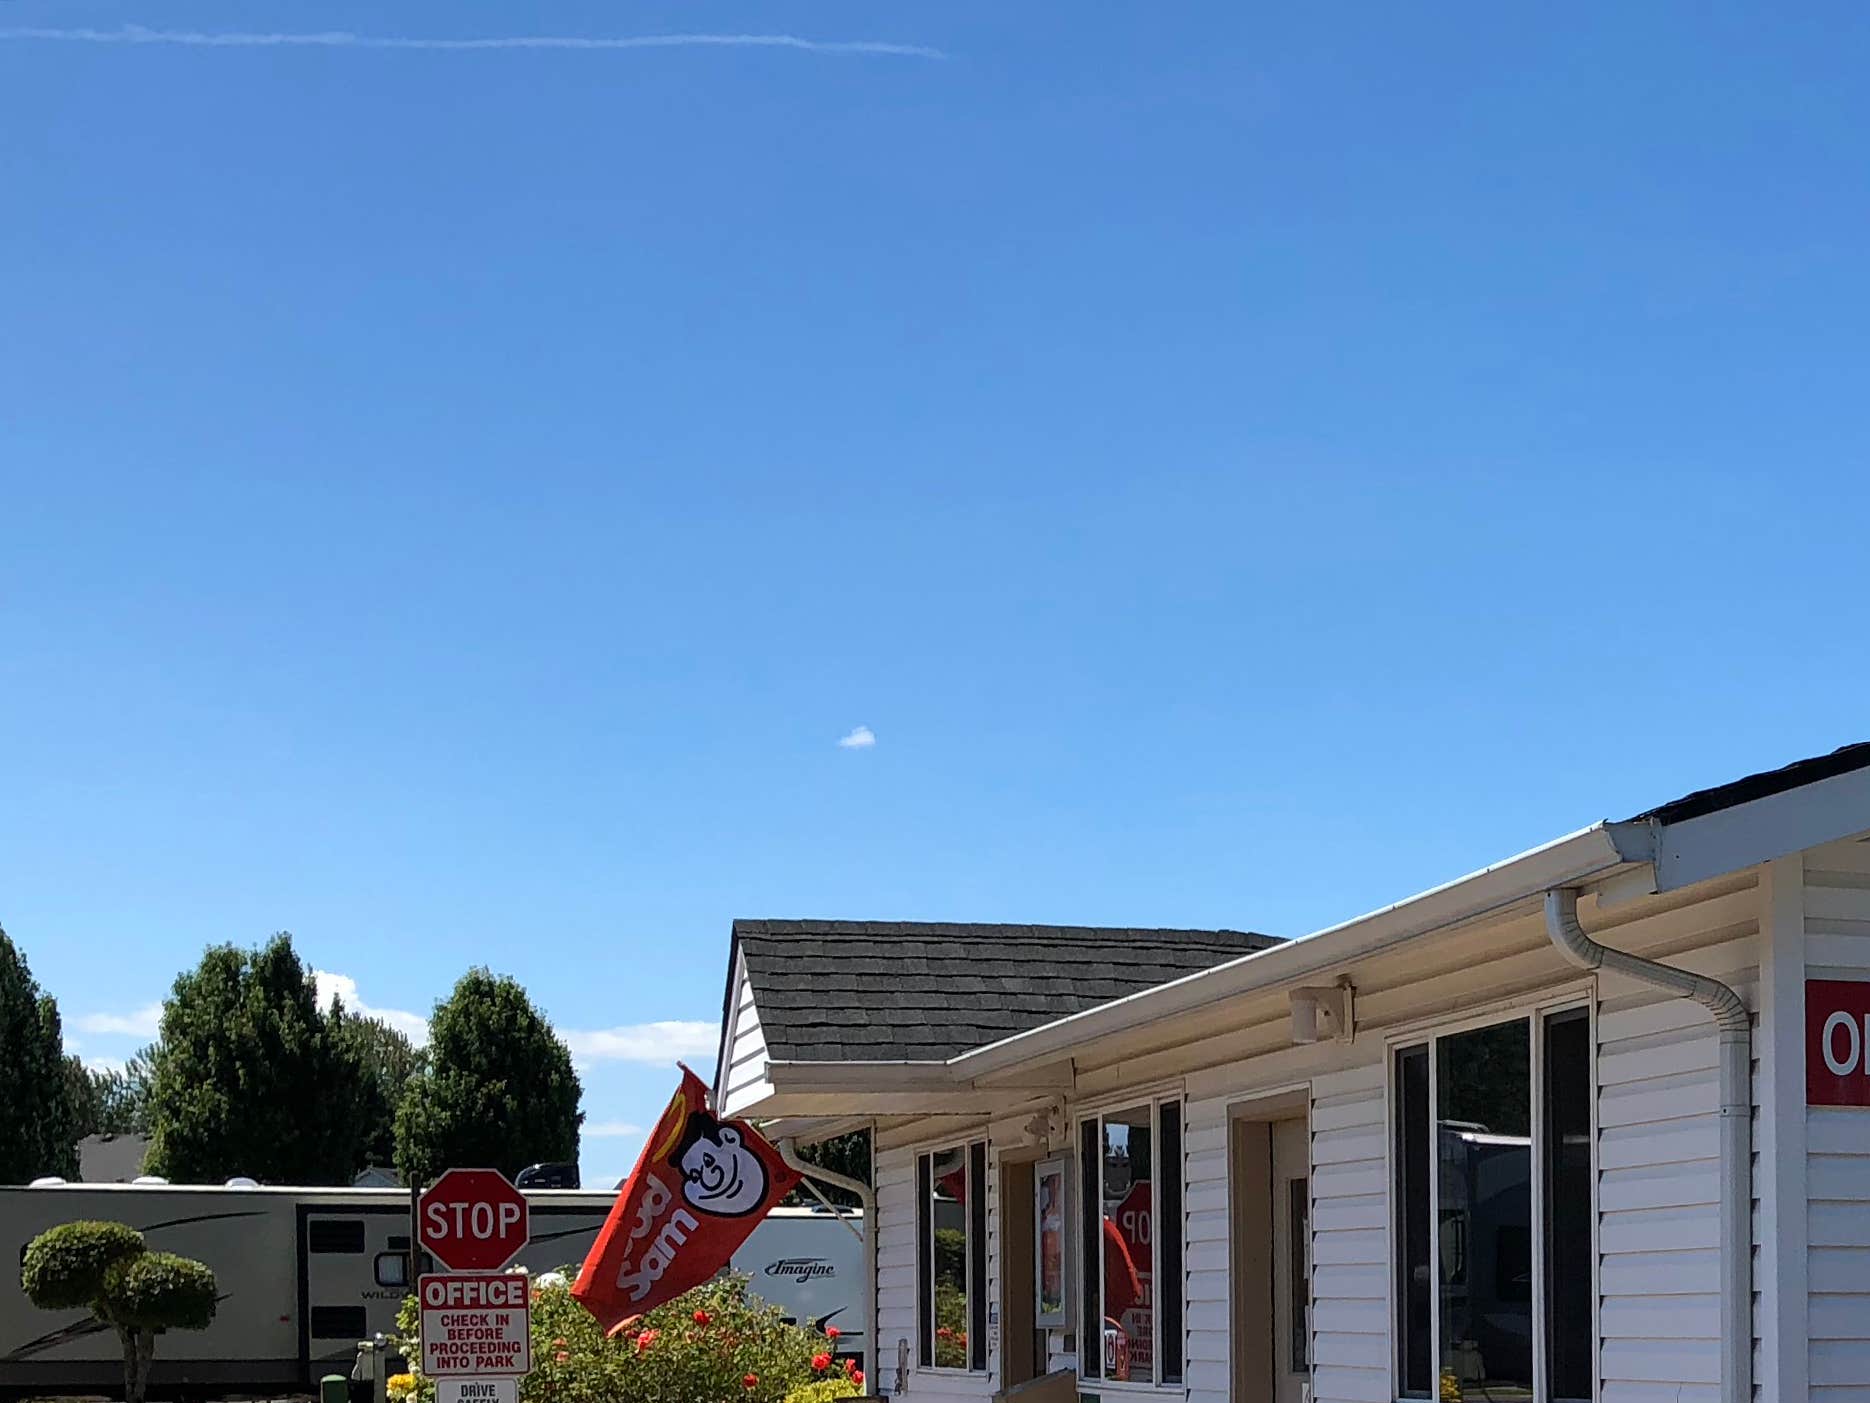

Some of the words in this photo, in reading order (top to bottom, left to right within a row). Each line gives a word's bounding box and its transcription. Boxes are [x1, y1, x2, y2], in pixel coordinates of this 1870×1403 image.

[426, 1201, 521, 1239] STOP
[615, 1207, 700, 1301] Sam
[769, 1258, 835, 1283] Imagine
[425, 1280, 524, 1307] OFFICE
[440, 1314, 489, 1327] CHECK
[495, 1313, 510, 1326] IN
[447, 1327, 504, 1341] BEFORE
[429, 1341, 522, 1355] PROCEEDING
[436, 1356, 470, 1369] INTO
[475, 1355, 515, 1368] PARK
[460, 1384, 496, 1397] DRIVE
